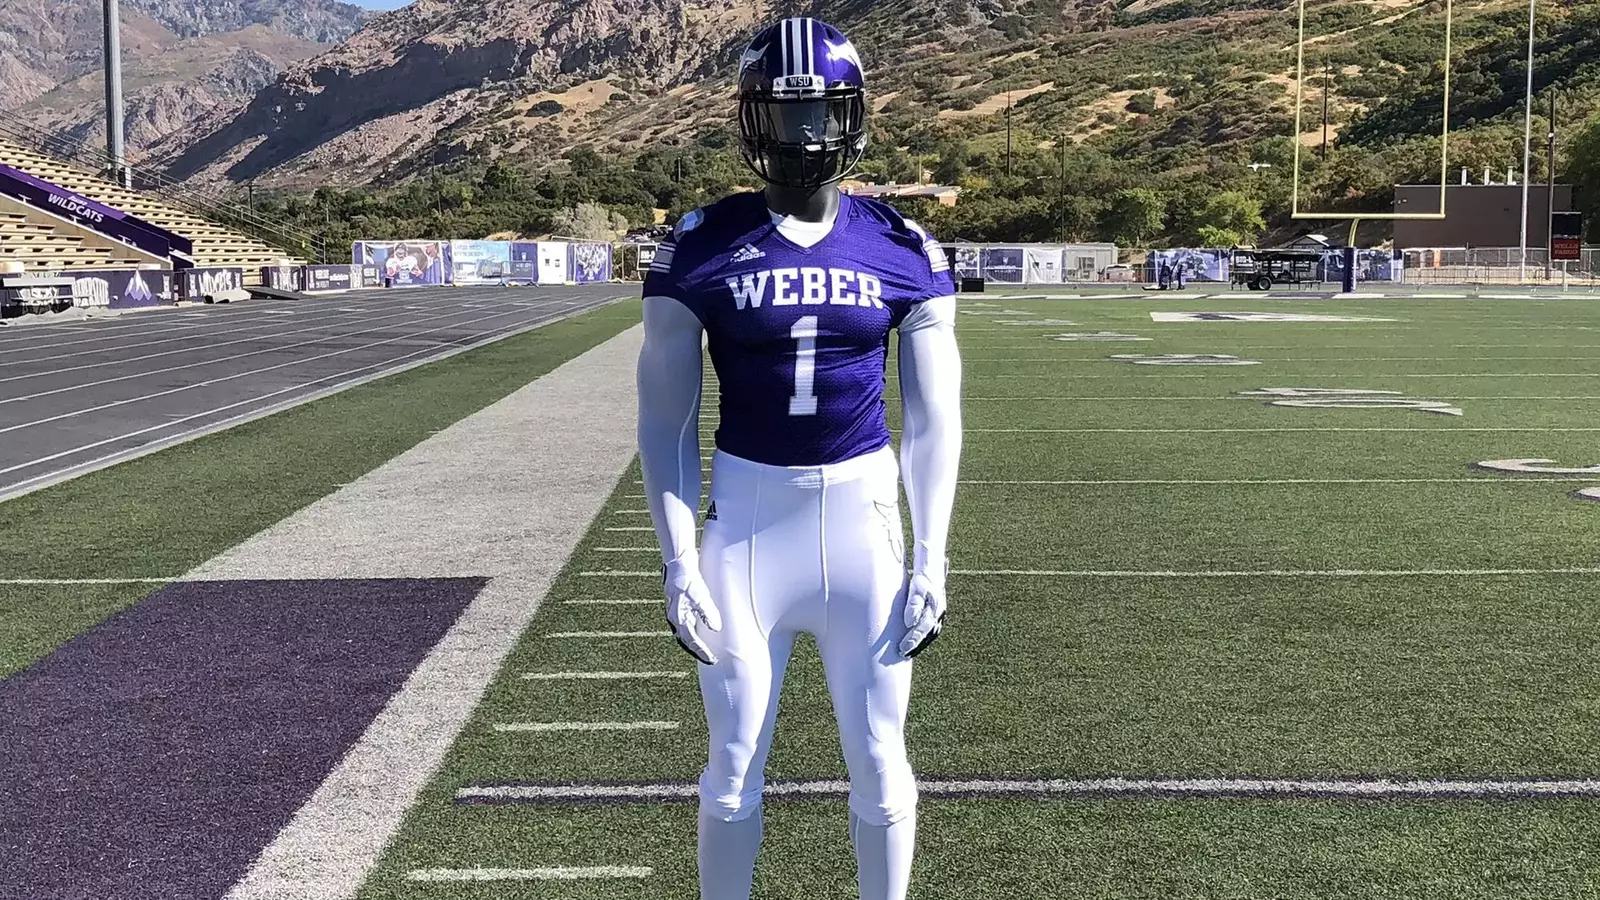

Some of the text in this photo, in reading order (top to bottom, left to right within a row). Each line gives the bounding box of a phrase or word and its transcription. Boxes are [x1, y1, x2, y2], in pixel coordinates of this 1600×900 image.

[789, 76, 810, 86] WSU
[48, 193, 104, 223] WILDCATS
[726, 267, 884, 310] WEBER
[788, 315, 818, 416] 1
